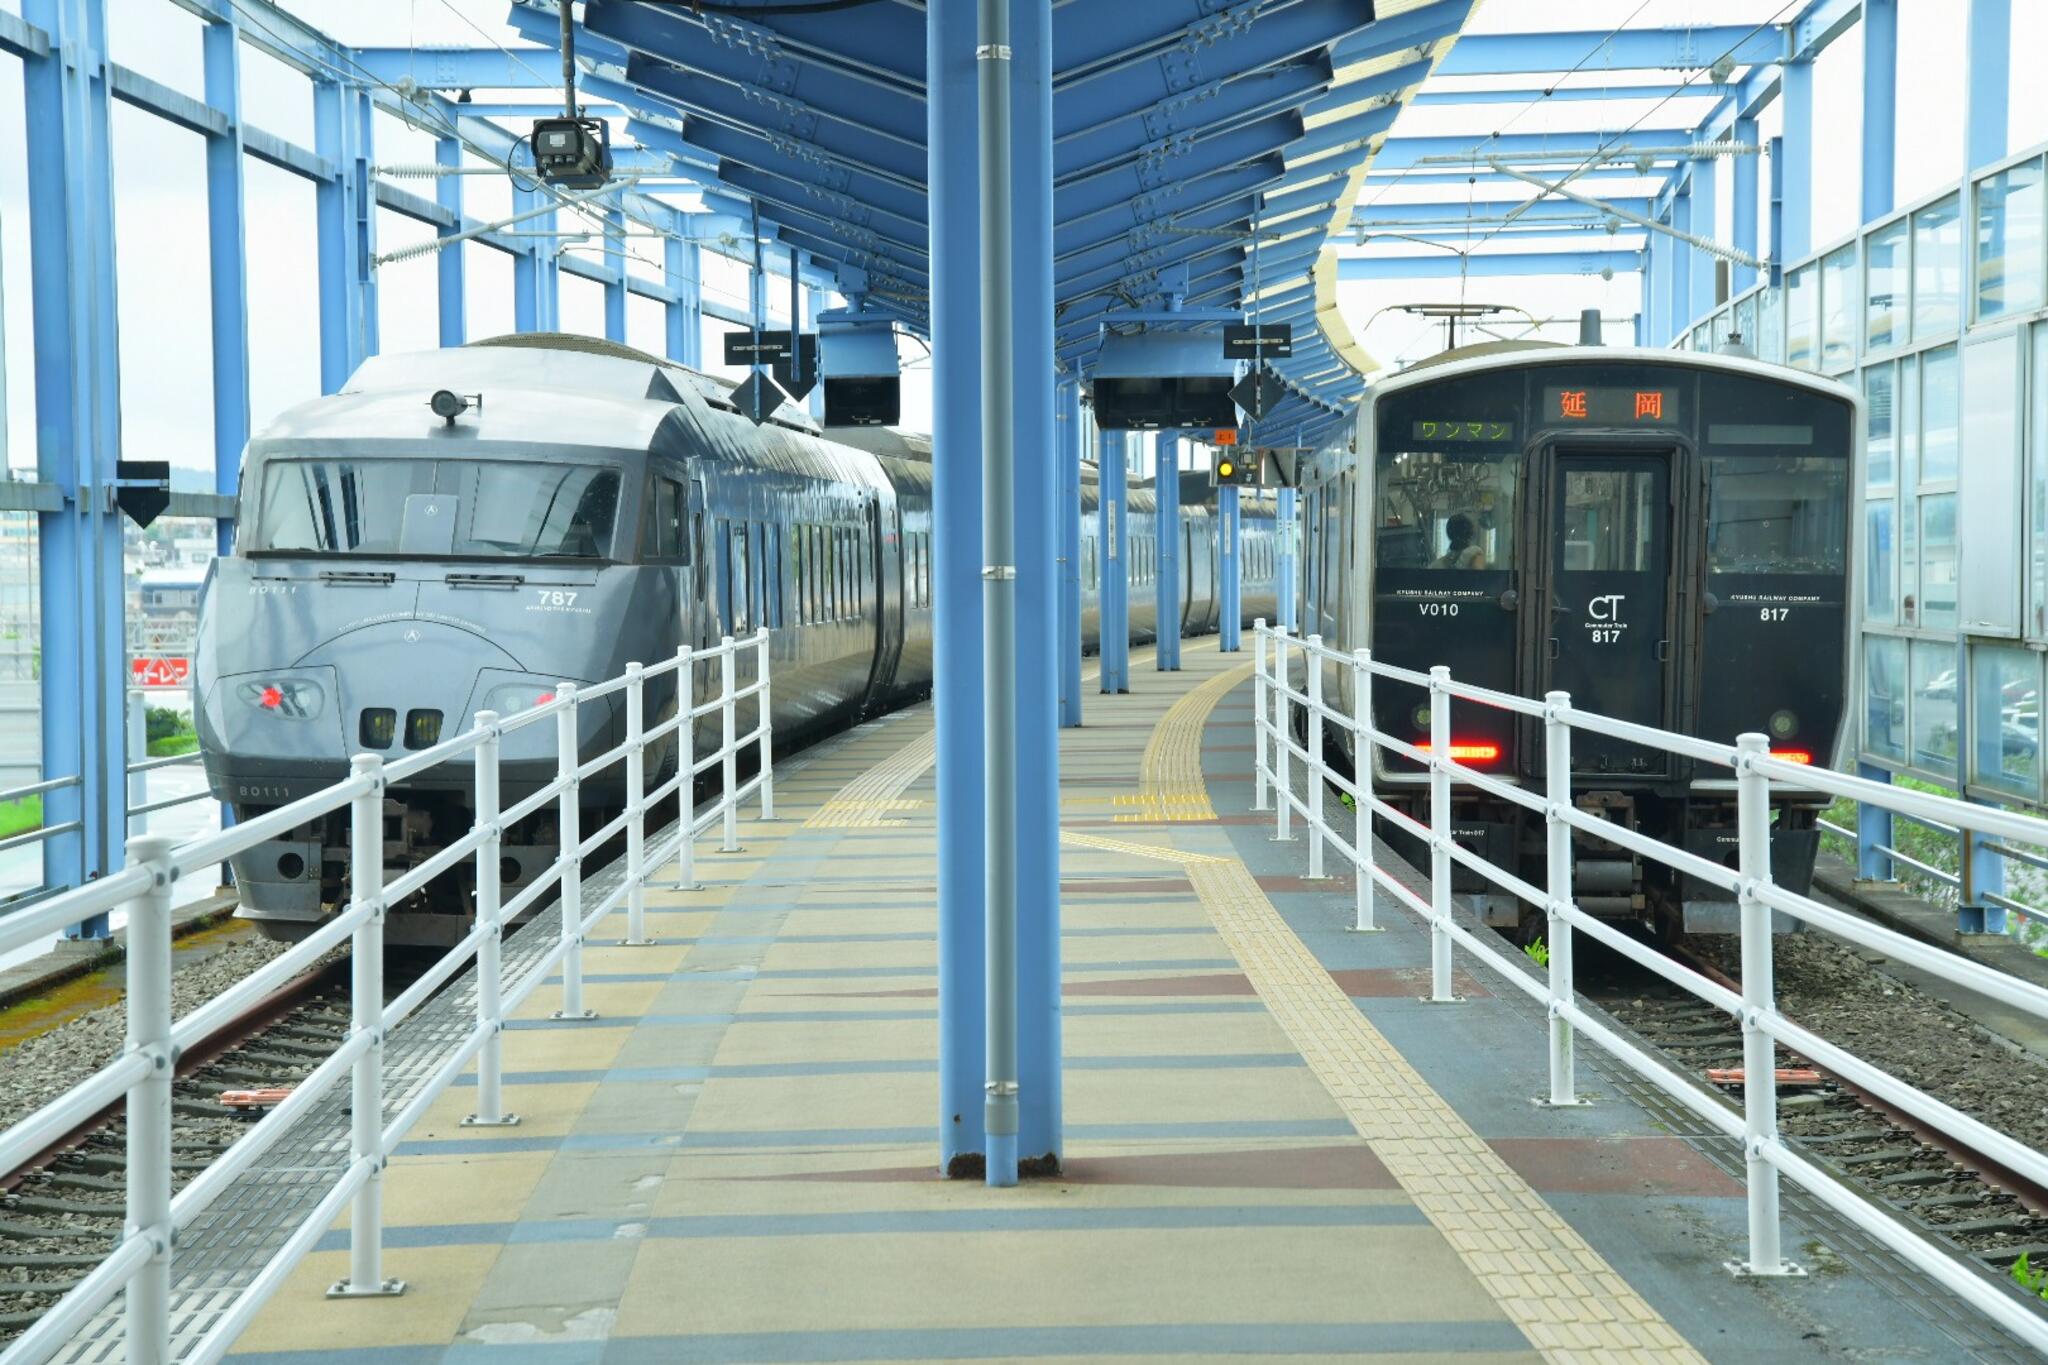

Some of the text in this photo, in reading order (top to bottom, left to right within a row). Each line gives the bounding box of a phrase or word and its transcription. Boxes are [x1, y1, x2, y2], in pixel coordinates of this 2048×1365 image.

[1421, 422, 1507, 439] ワンマン
[537, 590, 578, 606] 787
[1419, 603, 1459, 616] V010
[1588, 595, 1625, 621] CT
[1760, 608, 1789, 621] 817
[1592, 630, 1620, 643] 817
